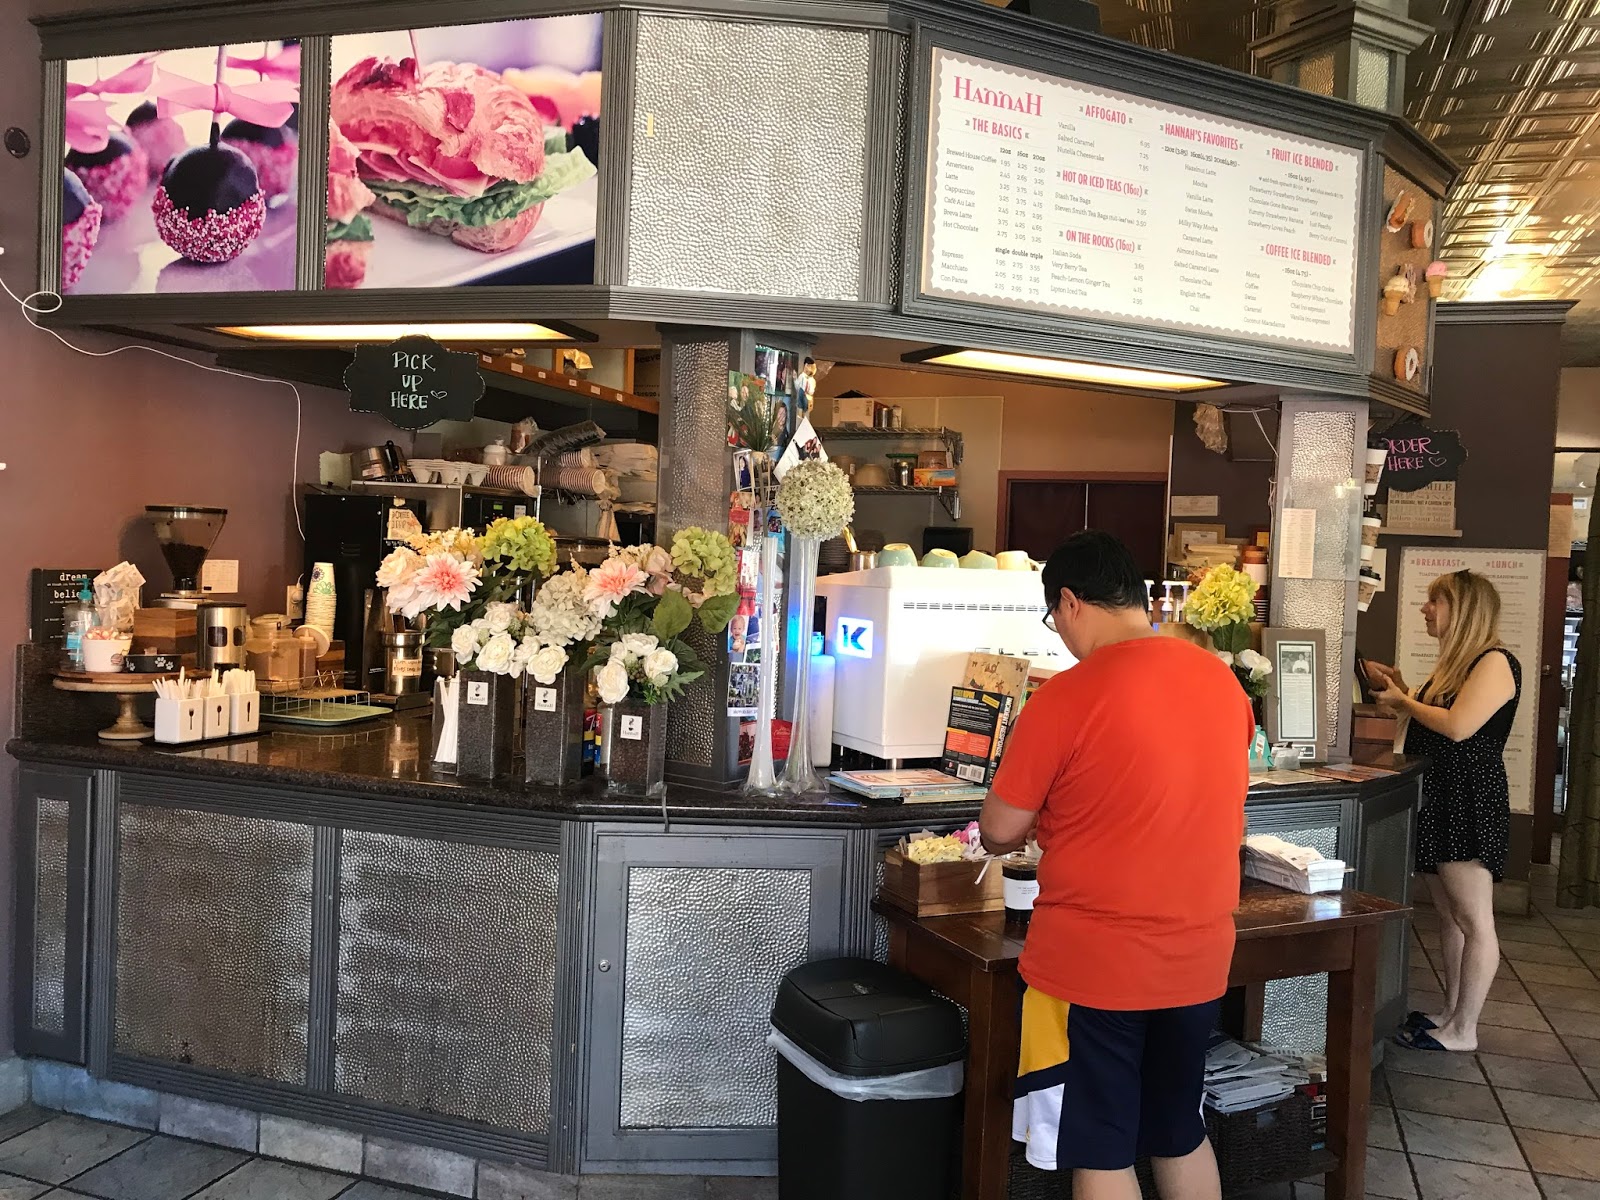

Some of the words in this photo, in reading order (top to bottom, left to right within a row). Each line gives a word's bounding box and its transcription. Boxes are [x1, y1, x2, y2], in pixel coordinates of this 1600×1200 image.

[953, 75, 1044, 117] HannaH
[1085, 104, 1127, 125] AFFOGATO
[972, 118, 989, 133] THE
[992, 122, 1023, 140] BASICS
[1058, 122, 1076, 132] Vanilla
[1074, 137, 1095, 148] Caramel
[1165, 123, 1202, 142] HANNAH'S
[1203, 131, 1239, 151] FAVORITES
[946, 160, 974, 172] Americano
[982, 155, 997, 165] Coffee
[1272, 147, 1291, 163] FRUIT
[1293, 152, 1303, 166] ICE
[1304, 155, 1334, 172] BLENDED
[945, 184, 975, 197] Cappuccino
[1062, 170, 1076, 183] HOT
[1078, 173, 1088, 185] OR
[1090, 175, 1104, 189] ICED
[1106, 179, 1122, 192] TEAS
[1123, 182, 1143, 198] (16oz)
[1193, 180, 1208, 188] Mocha
[1069, 195, 1079, 203] Tea
[953, 222, 979, 233] Chocolate
[1066, 230, 1076, 242] ON
[1078, 232, 1091, 245] THE
[1092, 234, 1114, 249] ROCKS
[1115, 238, 1135, 254] (16oz)
[1182, 233, 1202, 243] Caramel
[942, 250, 964, 260] Espresso
[995, 246, 1010, 255] single
[1012, 249, 1029, 258] double
[1030, 252, 1043, 261] triple
[1052, 249, 1069, 257] Italian
[1069, 251, 1082, 259] Soda
[1266, 243, 1289, 259] COFFEE
[1291, 248, 1301, 261] ICE
[1302, 250, 1332, 266] BLENDED
[941, 262, 968, 272] Macchiato
[392, 351, 436, 372] PICK
[402, 374, 423, 392] UP
[391, 391, 428, 410] HERE
[1387, 456, 1424, 472] HERE
[1416, 558, 1461, 567] BREAKFAST
[1491, 560, 1518, 569] LUNCH
[59, 572, 88, 582] dream
[54, 589, 80, 600] belie
[841, 624, 868, 651] K
[1002, 696, 1013, 726] INCIDENT
[995, 724, 1007, 758] RESPONSE
